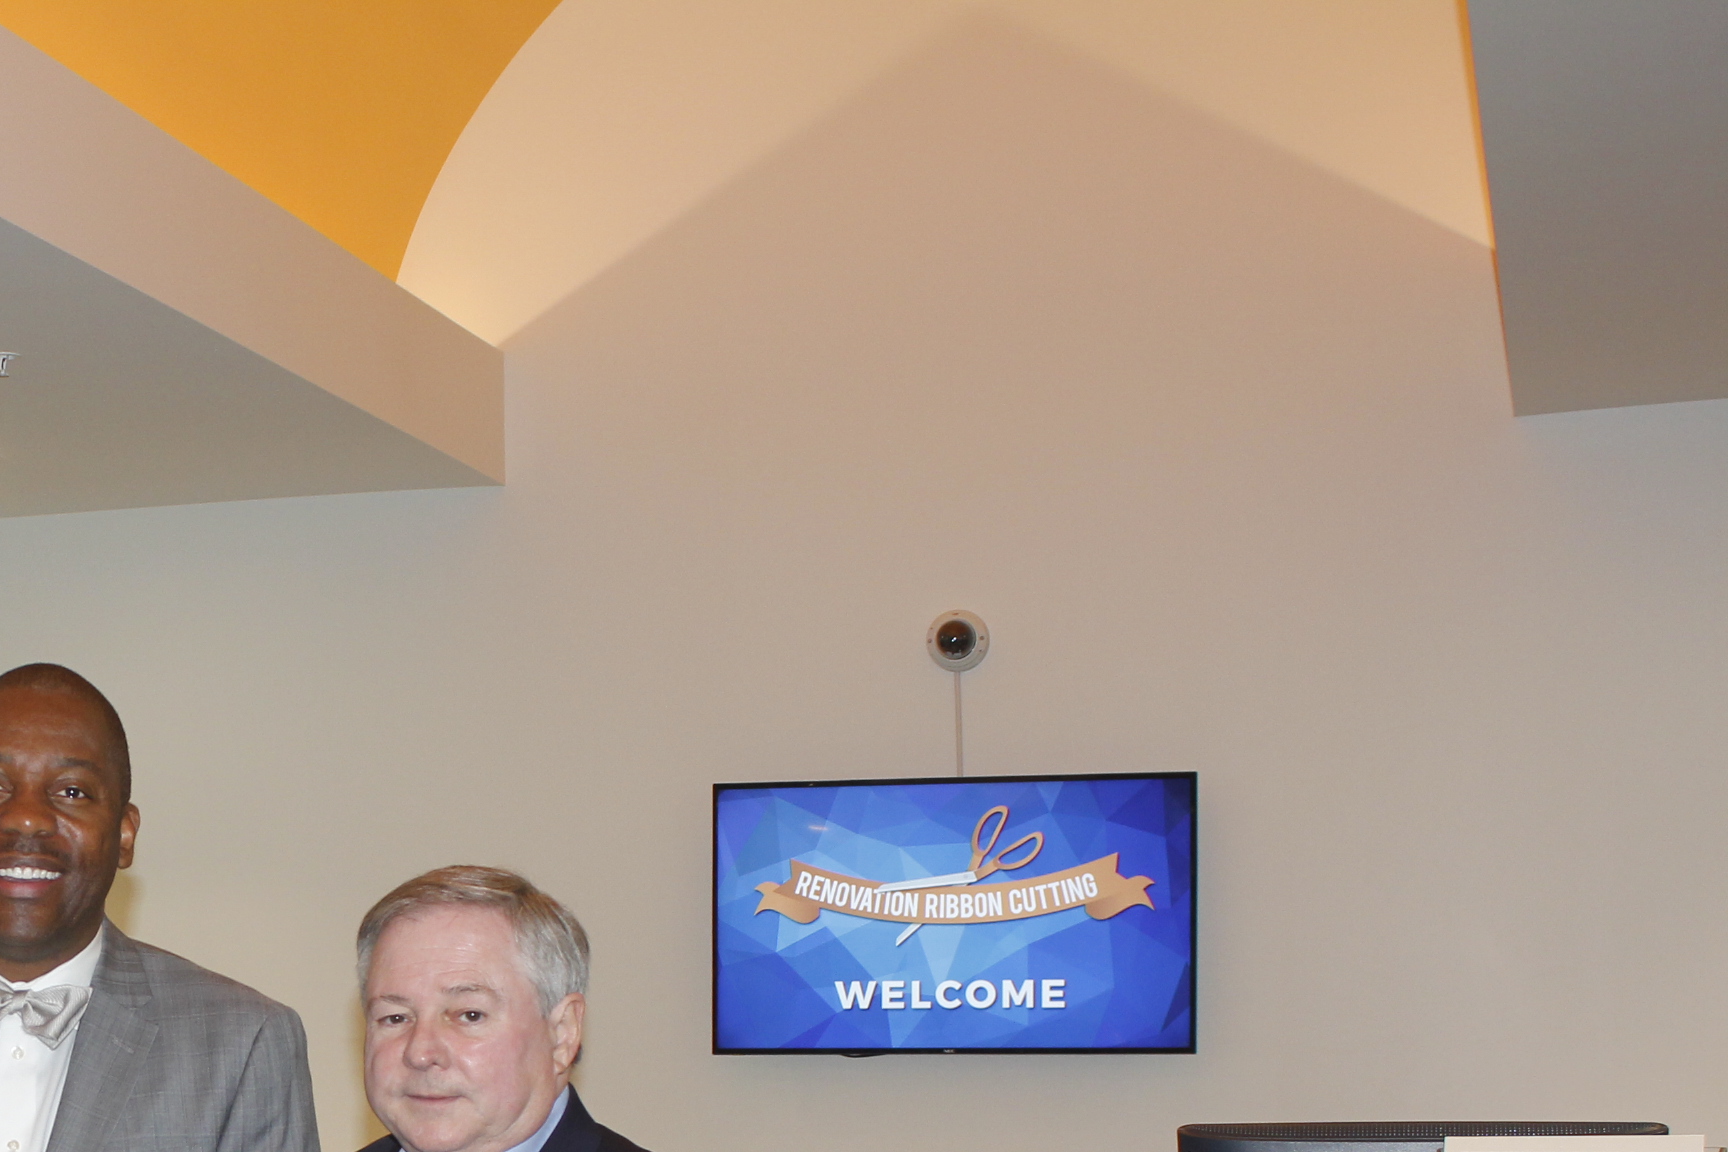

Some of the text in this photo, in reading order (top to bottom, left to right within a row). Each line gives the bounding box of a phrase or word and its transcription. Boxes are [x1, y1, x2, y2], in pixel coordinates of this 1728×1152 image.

[795, 870, 1099, 919] RENOVATION RIBBON CUTTING
[834, 979, 1067, 1010] WELCOME
